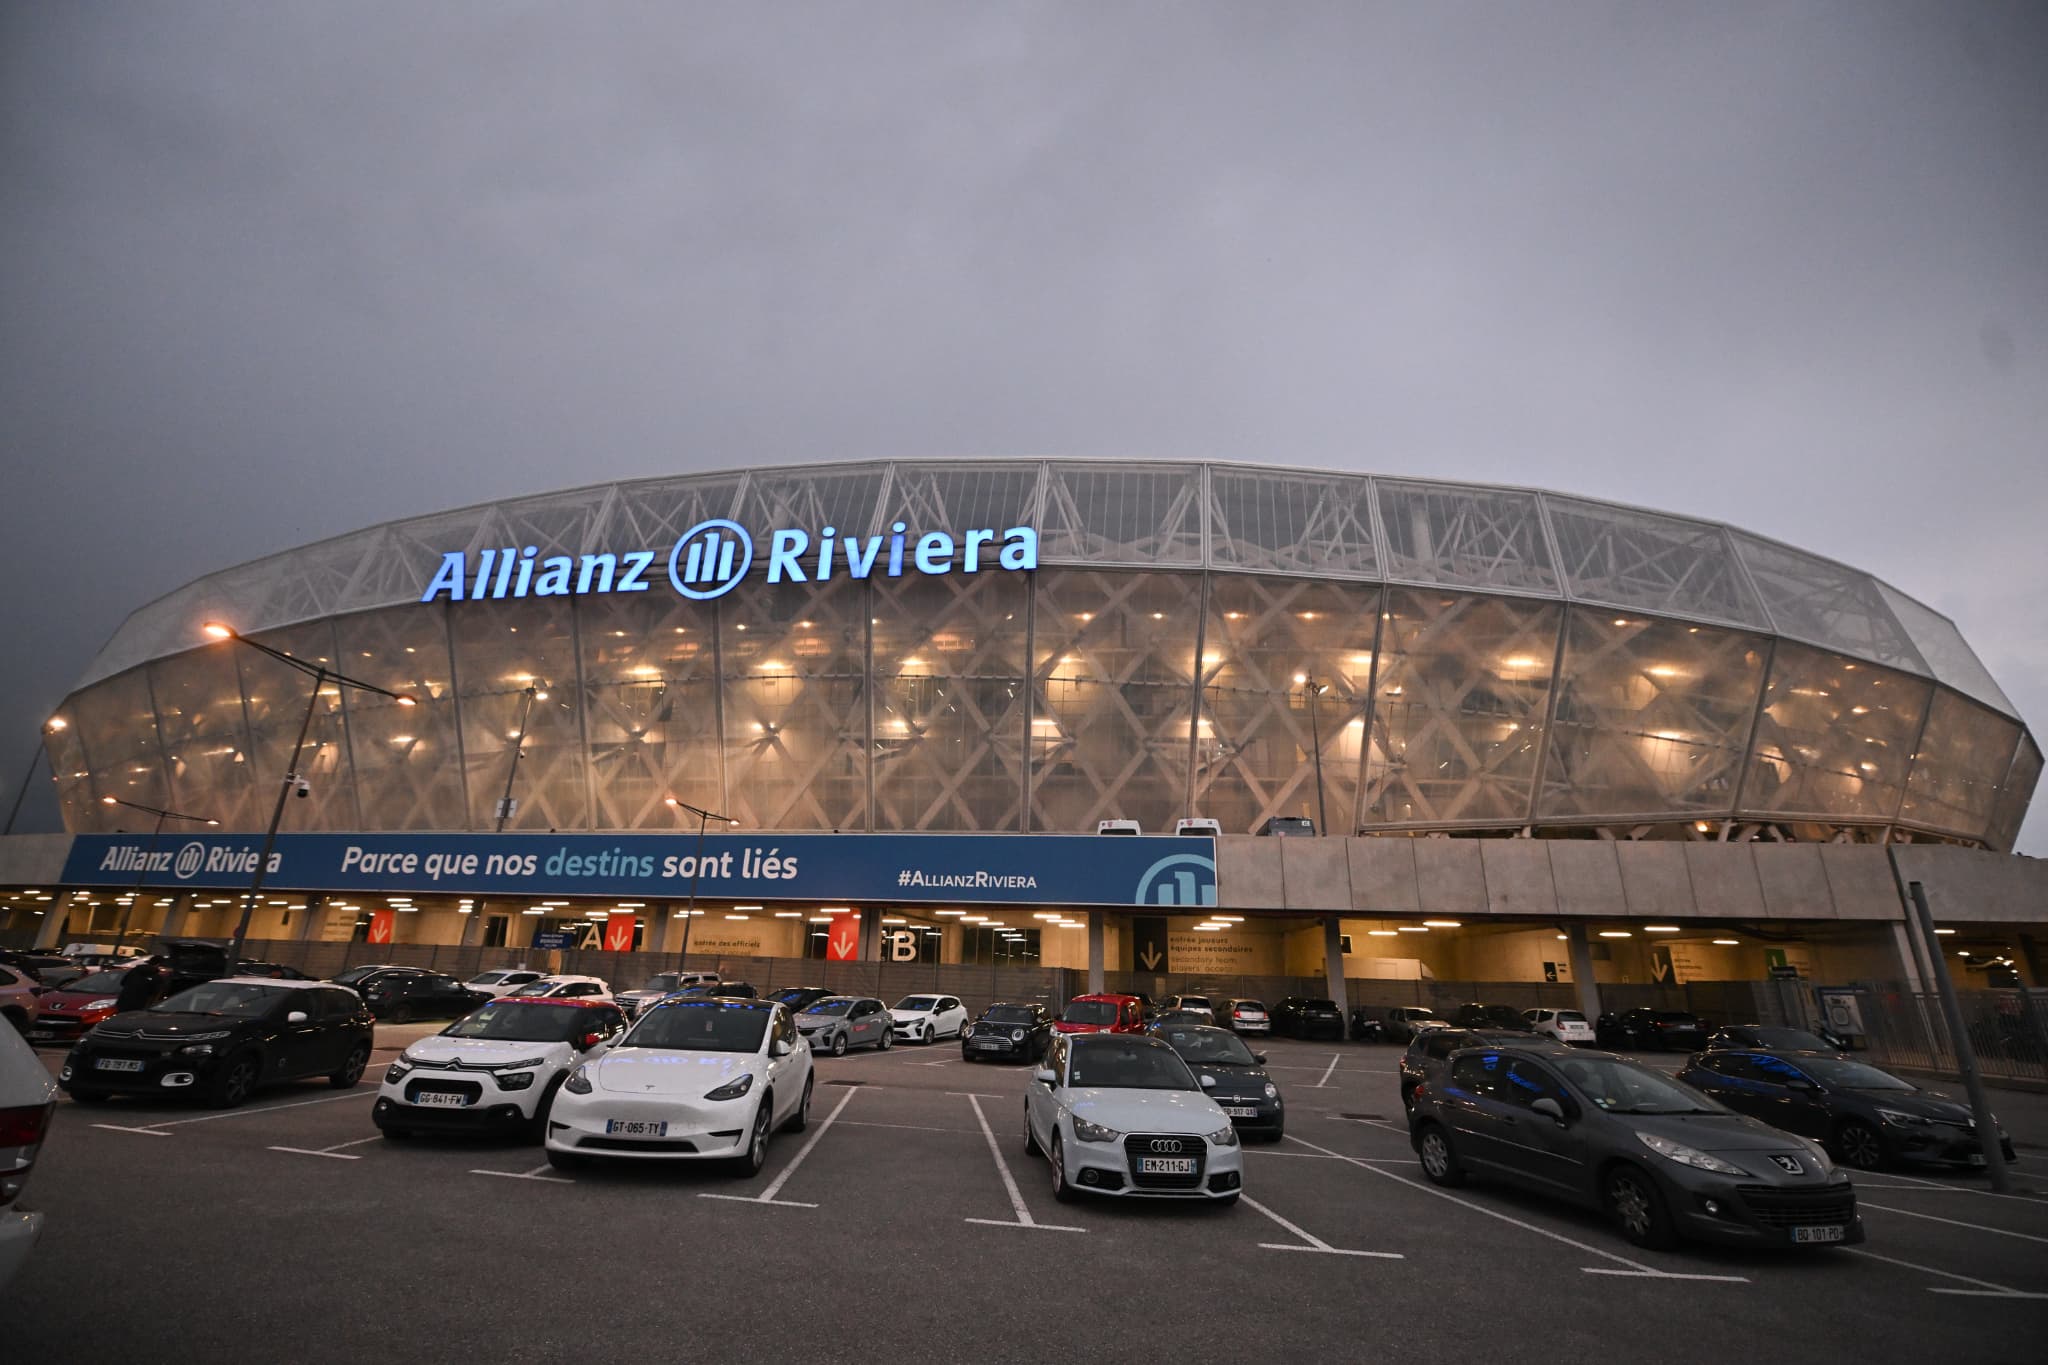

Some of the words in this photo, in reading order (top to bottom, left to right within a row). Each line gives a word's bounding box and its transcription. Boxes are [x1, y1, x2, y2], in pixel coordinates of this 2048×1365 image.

[421, 545, 655, 602] Allianz
[766, 521, 1039, 584] Riviera
[100, 846, 173, 872] Allianz
[204, 846, 282, 873] Riviea
[341, 846, 417, 874] Parce
[424, 853, 479, 880] que
[485, 853, 537, 877] nos
[545, 847, 655, 878] destins
[662, 852, 733, 879] sont
[742, 847, 798, 880] liés
[892, 931, 917, 962] B
[1144, 1159, 1190, 1172] EM-211-GJ
